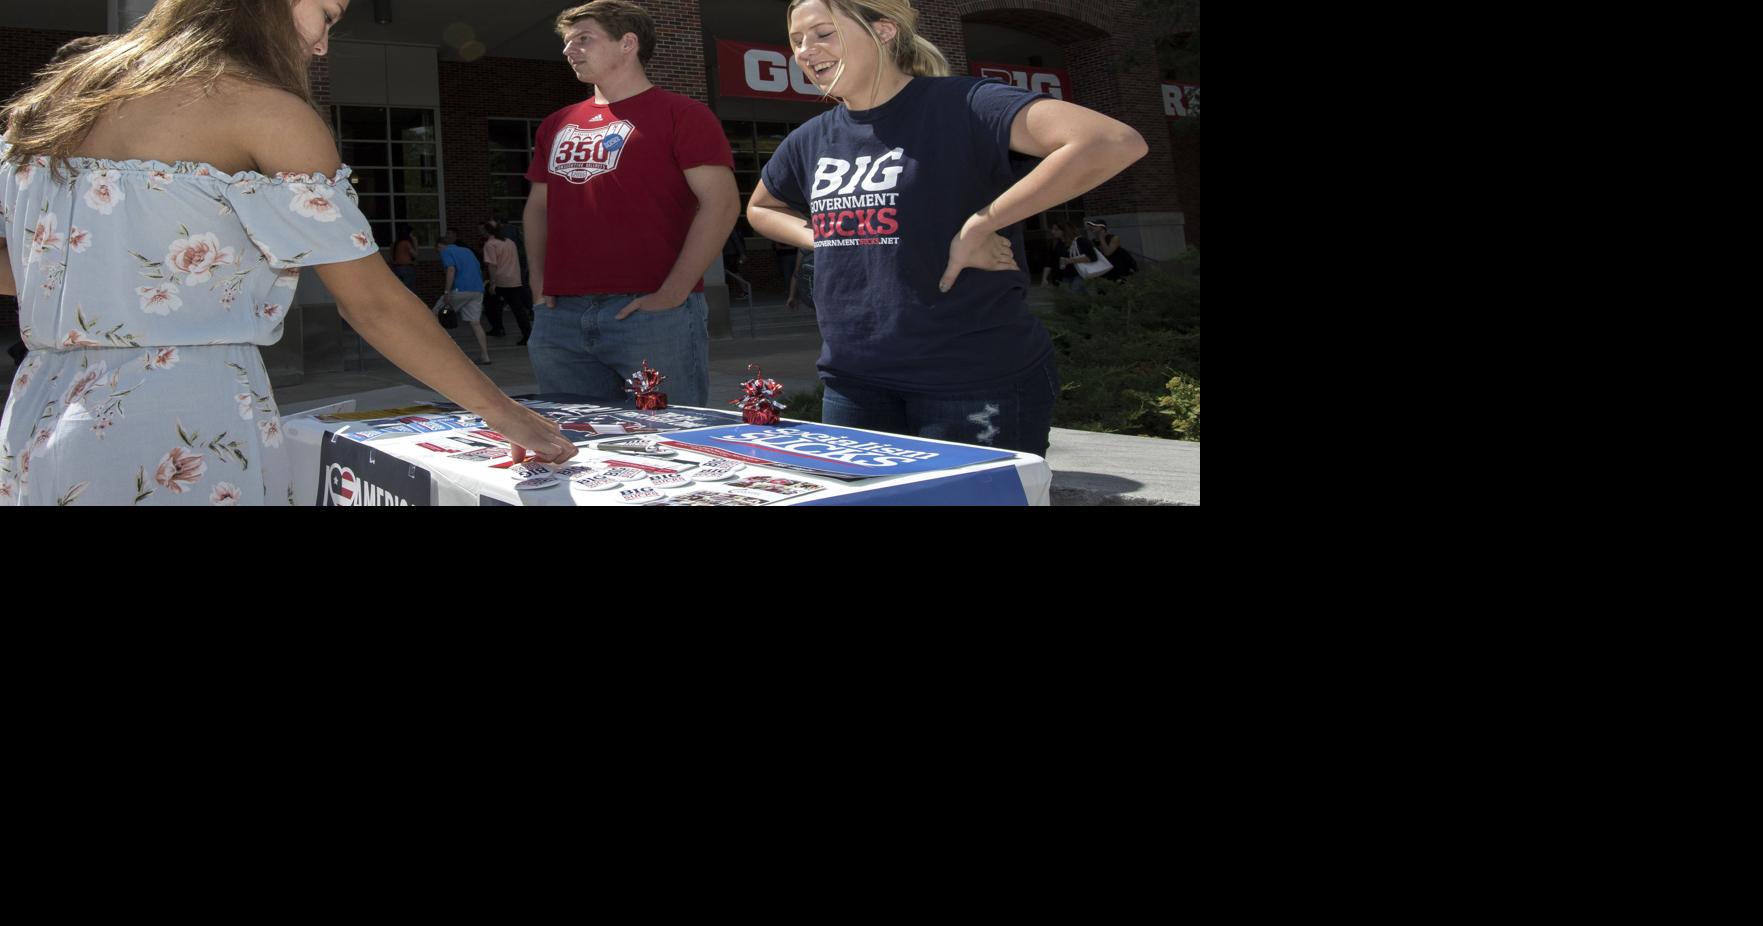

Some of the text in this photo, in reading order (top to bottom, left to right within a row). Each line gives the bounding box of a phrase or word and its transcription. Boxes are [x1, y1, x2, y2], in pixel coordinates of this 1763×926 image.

[555, 140, 608, 163] 350
[811, 147, 904, 199] BIG
[812, 208, 899, 240] SUCKS
[712, 432, 919, 467] SUCKS
[518, 467, 550, 478] BIG
[620, 486, 654, 496] BIG
